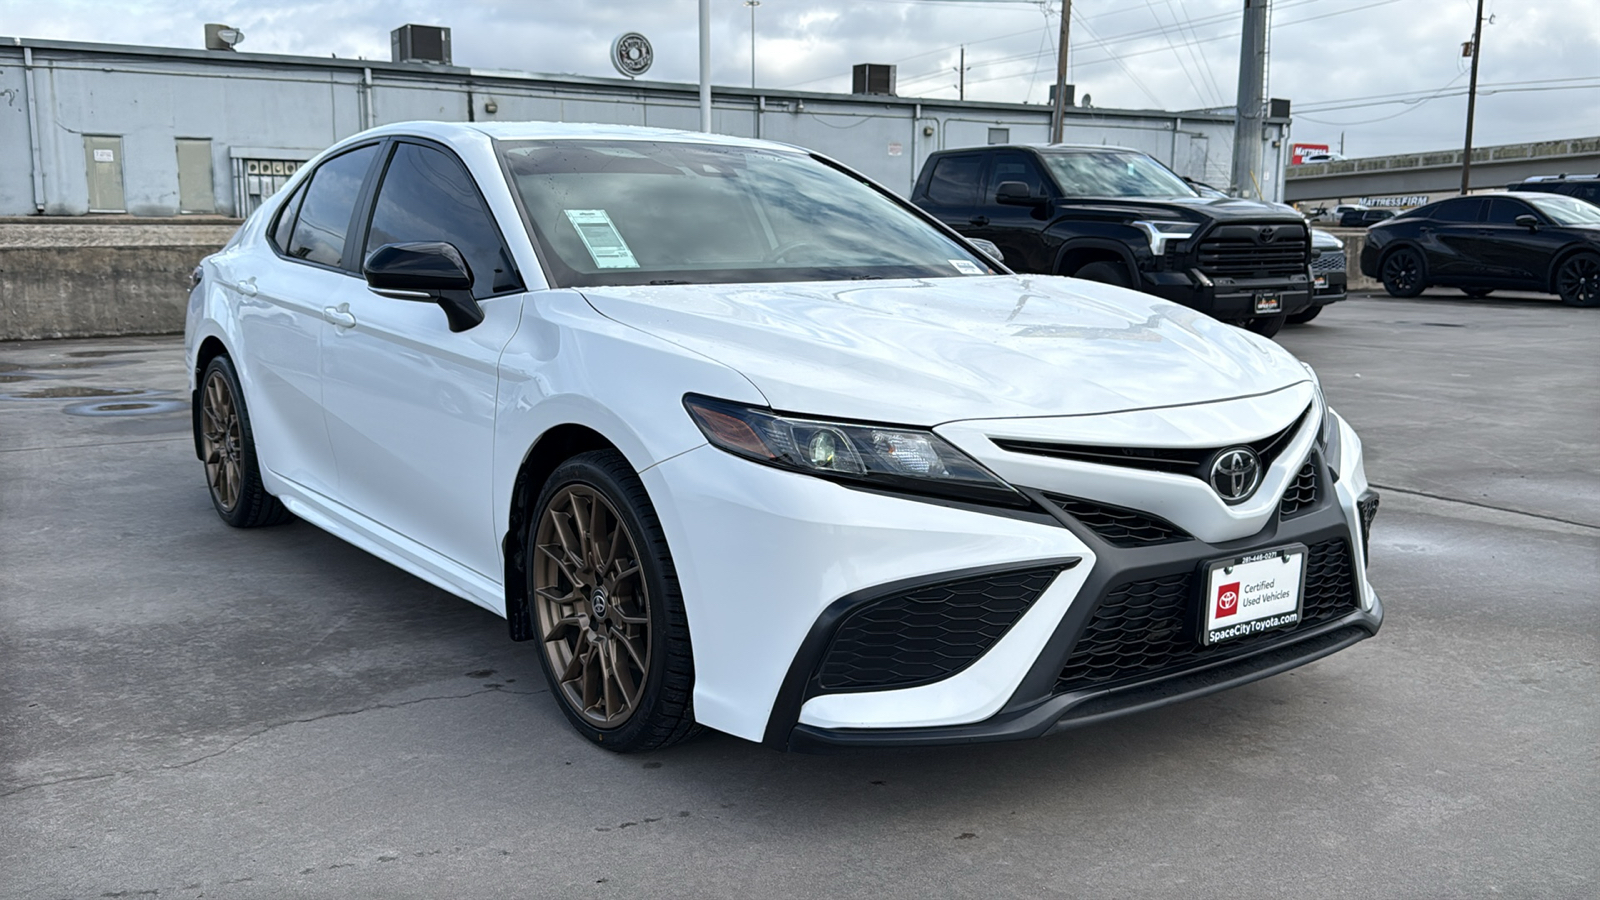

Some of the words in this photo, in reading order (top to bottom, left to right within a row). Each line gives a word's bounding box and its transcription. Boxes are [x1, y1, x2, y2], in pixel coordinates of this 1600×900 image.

[1244, 579, 1275, 594] Certified
[1242, 597, 1261, 607] Used
[1262, 590, 1290, 603] Vehicles
[1209, 613, 1298, 642] SpaceCityToyota.com
